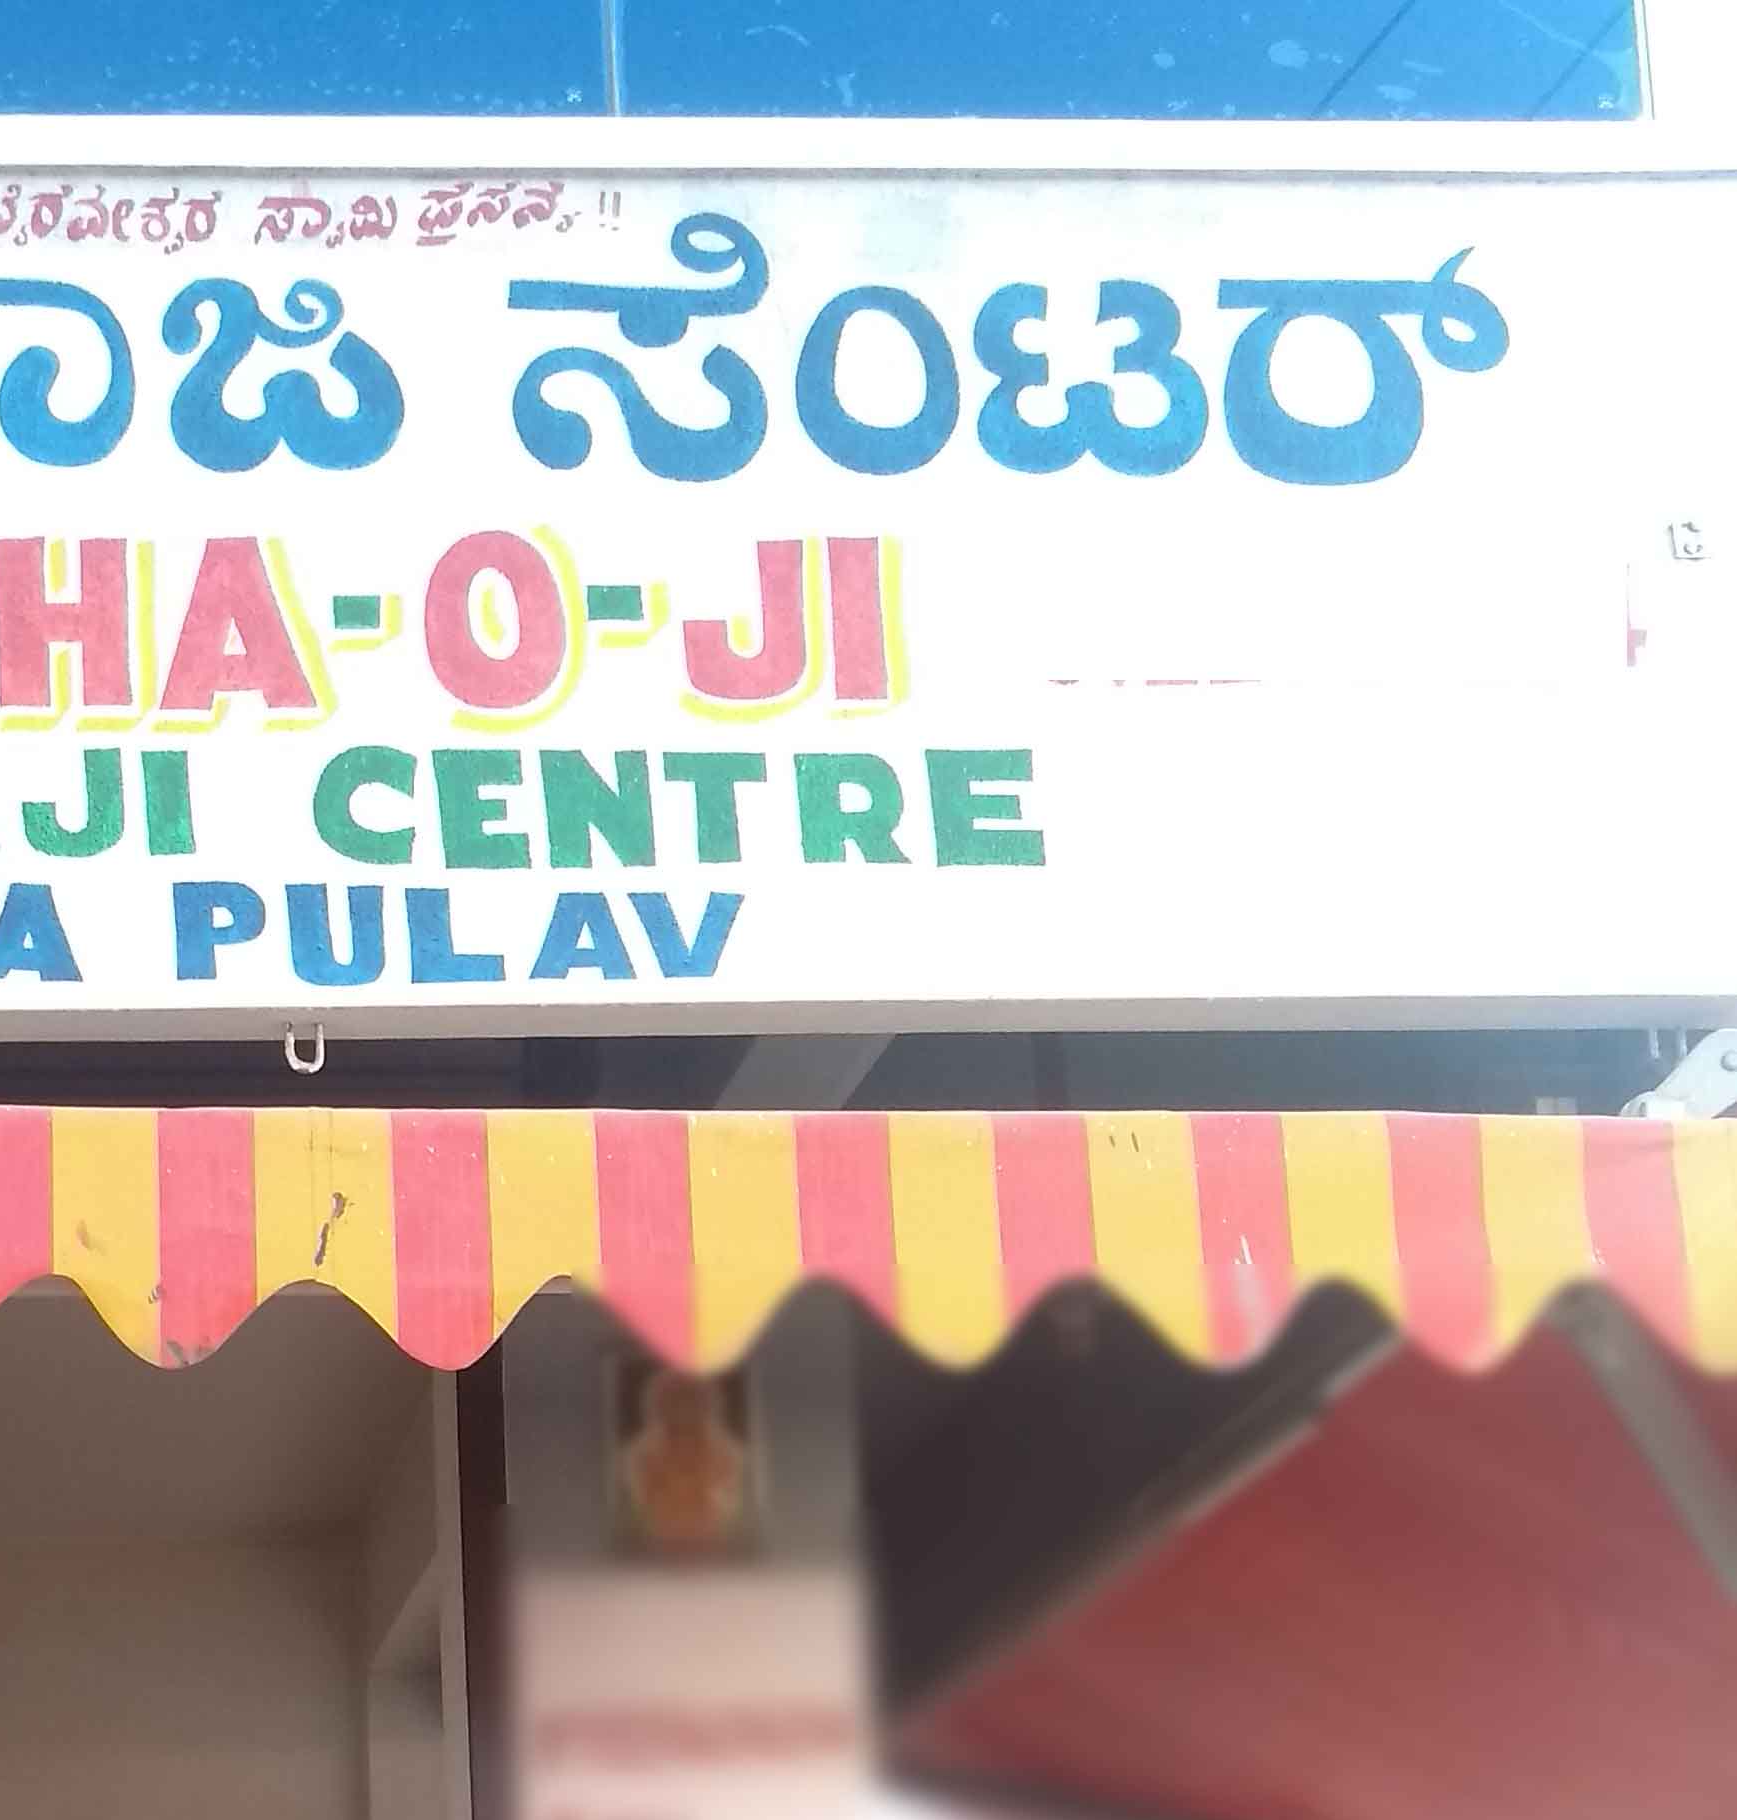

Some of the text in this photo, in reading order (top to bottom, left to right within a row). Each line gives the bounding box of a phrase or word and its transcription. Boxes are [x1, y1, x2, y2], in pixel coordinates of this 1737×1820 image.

[255, 194, 398, 249] ಸ್ವಾಮಿ
[506, 210, 1509, 487] ಸೆಂಟರ್
[312, 745, 1046, 868] CENTRE
[172, 880, 745, 988] PULAV
